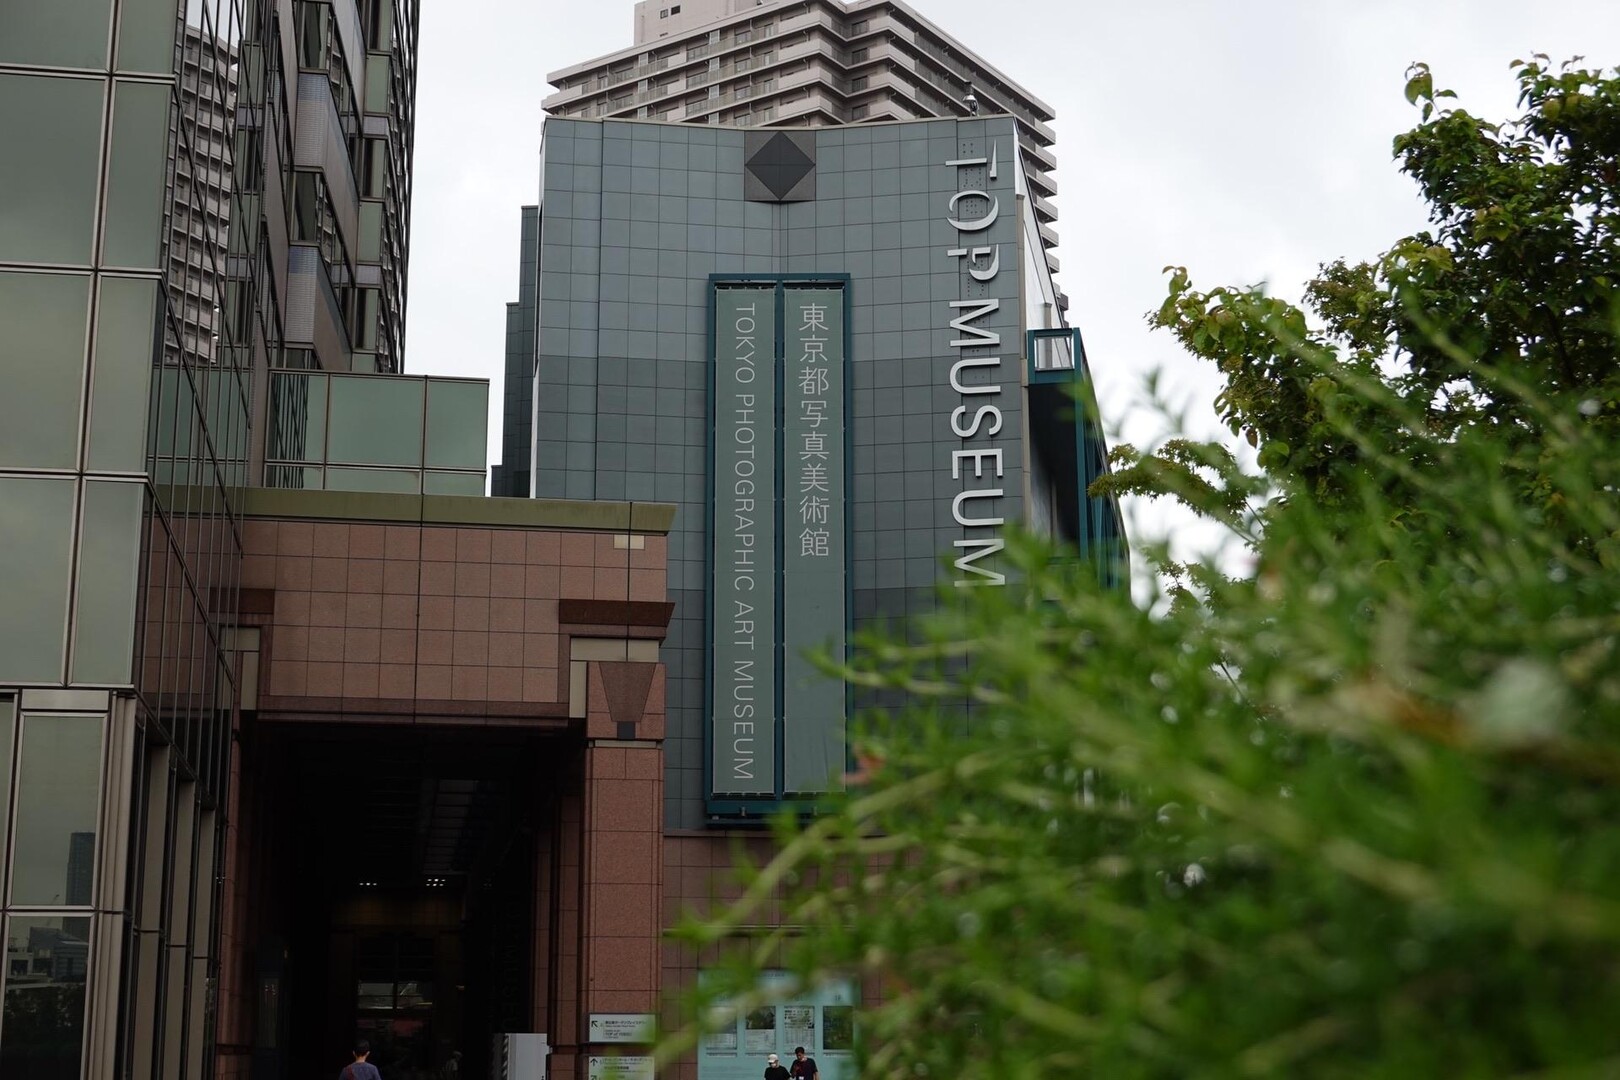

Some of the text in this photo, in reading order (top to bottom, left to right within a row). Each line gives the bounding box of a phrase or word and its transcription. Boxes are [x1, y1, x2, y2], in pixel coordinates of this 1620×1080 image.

[733, 303, 755, 779] TOKYO PHOTOGRAPHIC ART MUSEUM
[798, 303, 830, 557] 東京都写真美術館
[945, 139, 1005, 587] TOP MUSEUM
